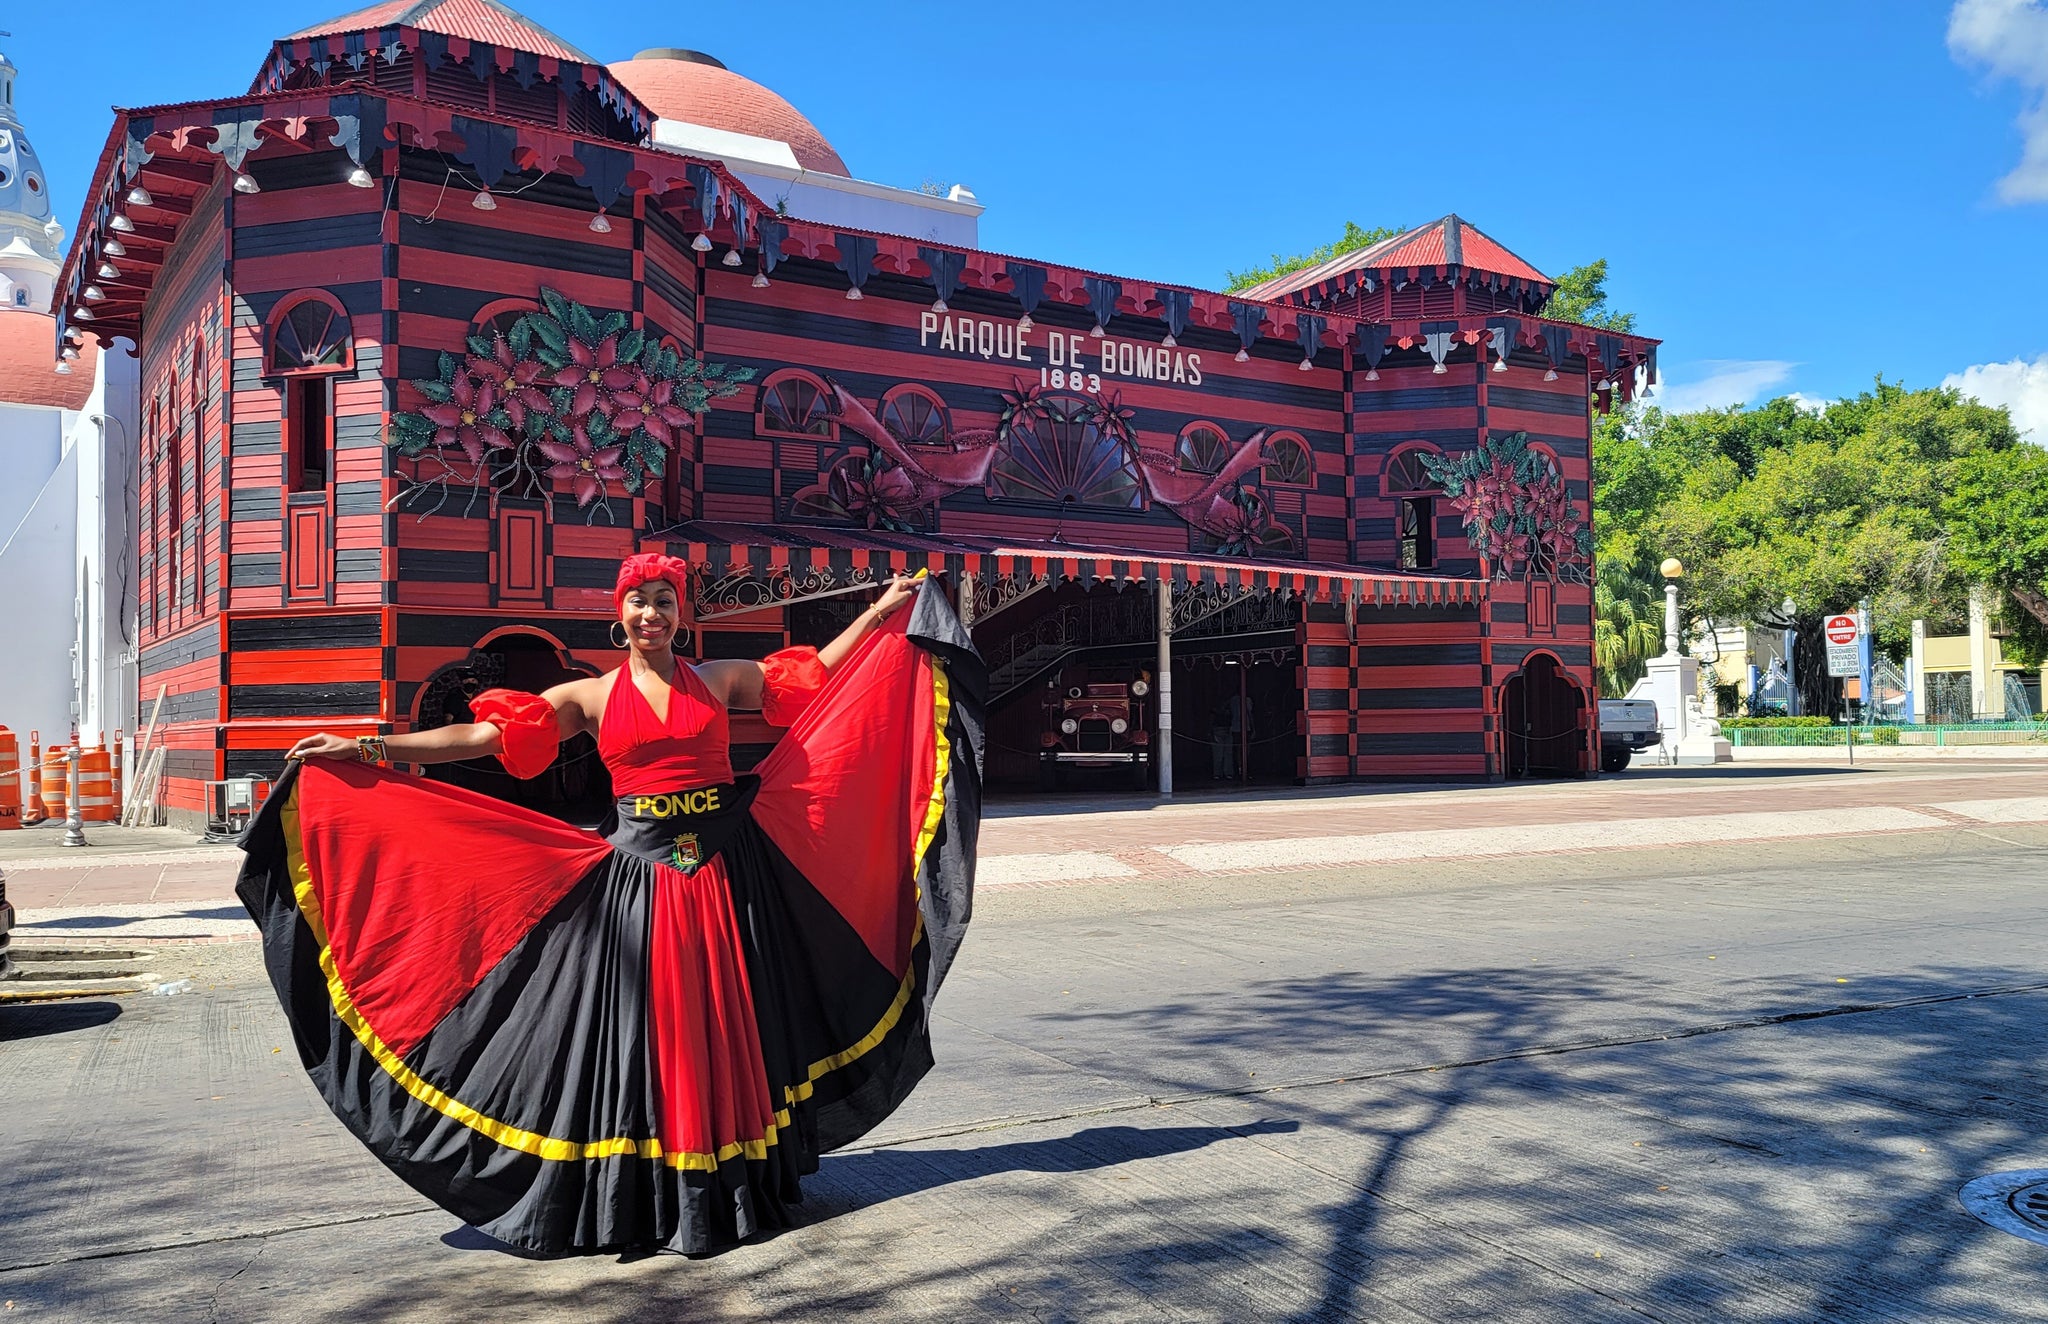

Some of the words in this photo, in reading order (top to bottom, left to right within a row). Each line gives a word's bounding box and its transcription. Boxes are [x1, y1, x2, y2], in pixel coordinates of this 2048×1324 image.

[920, 311, 1033, 362] PARQUE
[1048, 331, 1086, 370] DE
[1101, 339, 1203, 387] BOMBAS
[1040, 367, 1101, 394] 1883
[634, 787, 721, 818] PONCE
